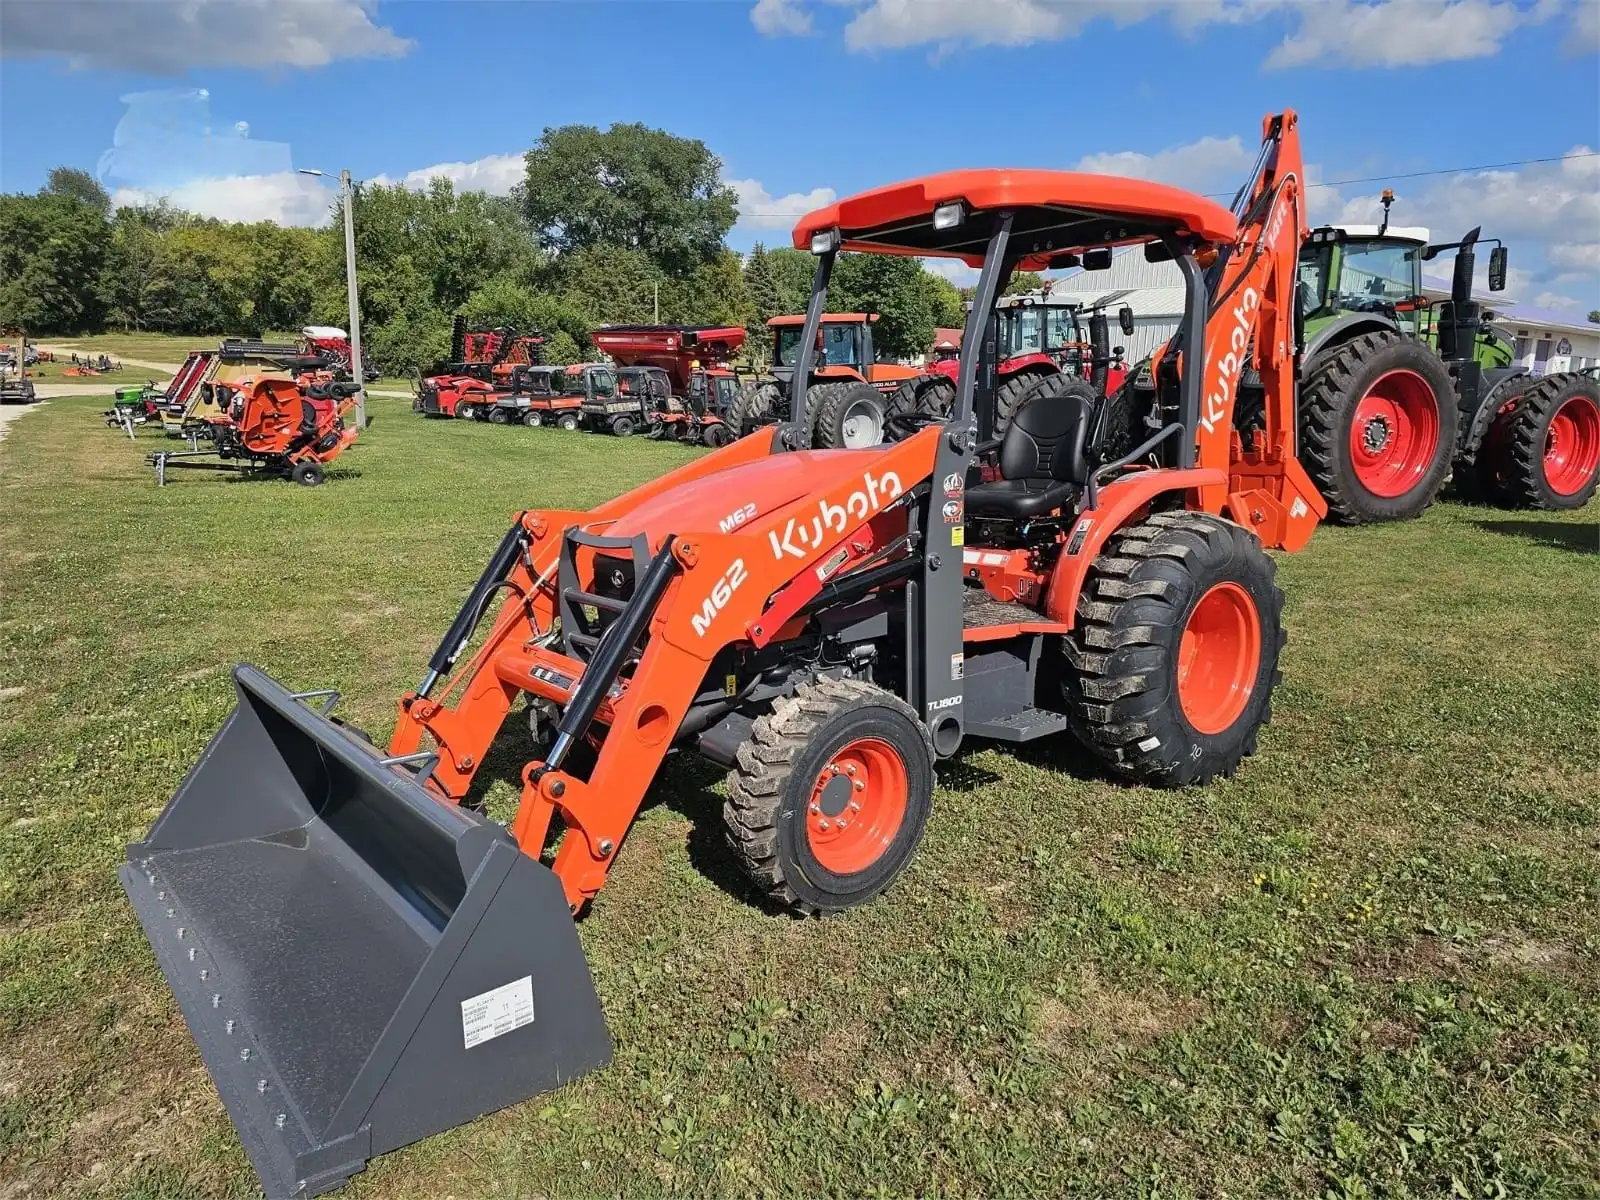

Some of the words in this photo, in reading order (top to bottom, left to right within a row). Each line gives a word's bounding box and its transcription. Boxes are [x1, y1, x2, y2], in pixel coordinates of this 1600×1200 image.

[1202, 287, 1258, 435] Kubota
[719, 502, 758, 534] M62
[769, 471, 903, 560] Kubota
[691, 558, 748, 638] M62
